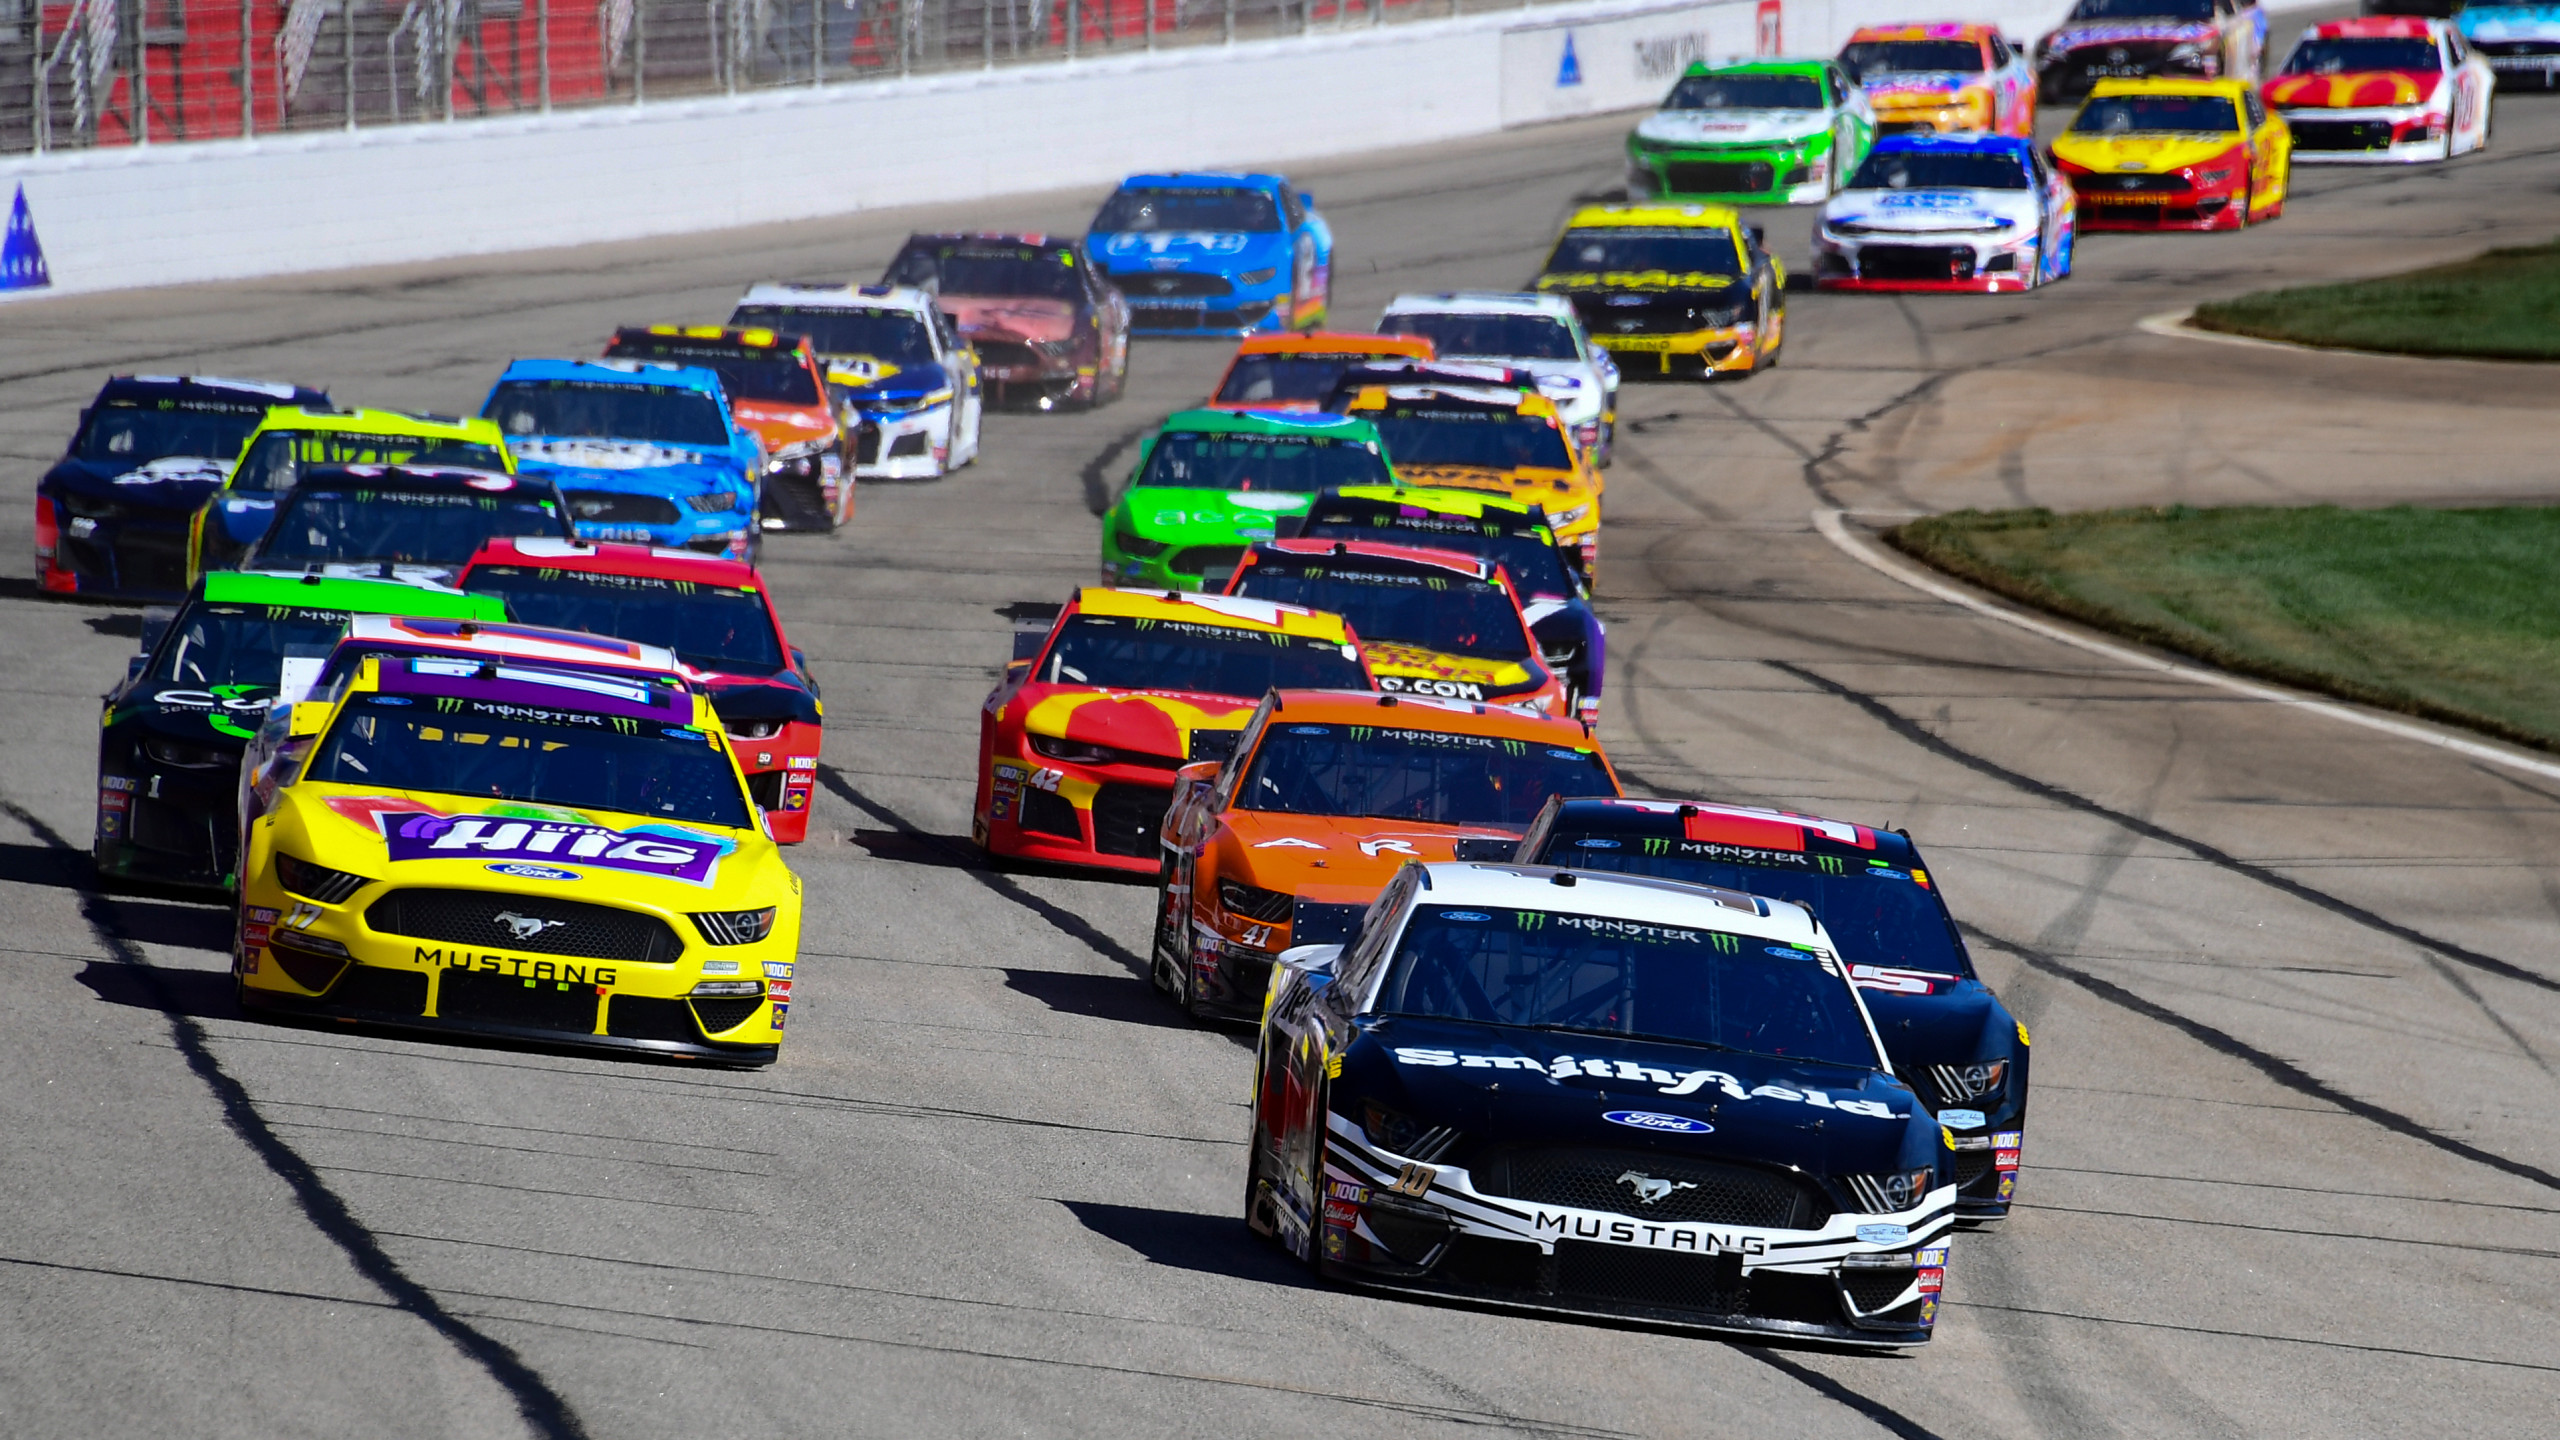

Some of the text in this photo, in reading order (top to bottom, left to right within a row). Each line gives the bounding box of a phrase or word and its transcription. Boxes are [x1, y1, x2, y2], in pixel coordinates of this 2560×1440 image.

[567, 570, 668, 589] MONSTER
[1329, 570, 1422, 586] MONSTER
[1163, 621, 1263, 641] MONSTER
[1379, 677, 1483, 701] O.COM
[473, 702, 603, 726] MONSTER
[1381, 729, 1496, 749] MONSTER
[147, 774, 162, 799] 1
[1030, 767, 1064, 792] 42
[1680, 842, 1809, 865] MONSTER
[504, 864, 564, 880] Ford
[285, 902, 324, 931] 17
[1241, 924, 1273, 948] 41
[1557, 916, 1702, 944] MONSTER
[1591, 931, 1671, 946] ENERGY
[415, 946, 617, 986] MUSTANG
[1394, 1047, 1898, 1120] Smithfield
[1625, 1111, 1693, 1131] Ford
[1388, 1162, 1437, 1197] 10
[1328, 1181, 1371, 1204] MOOG
[1535, 1210, 1771, 1256] MUSTANG
